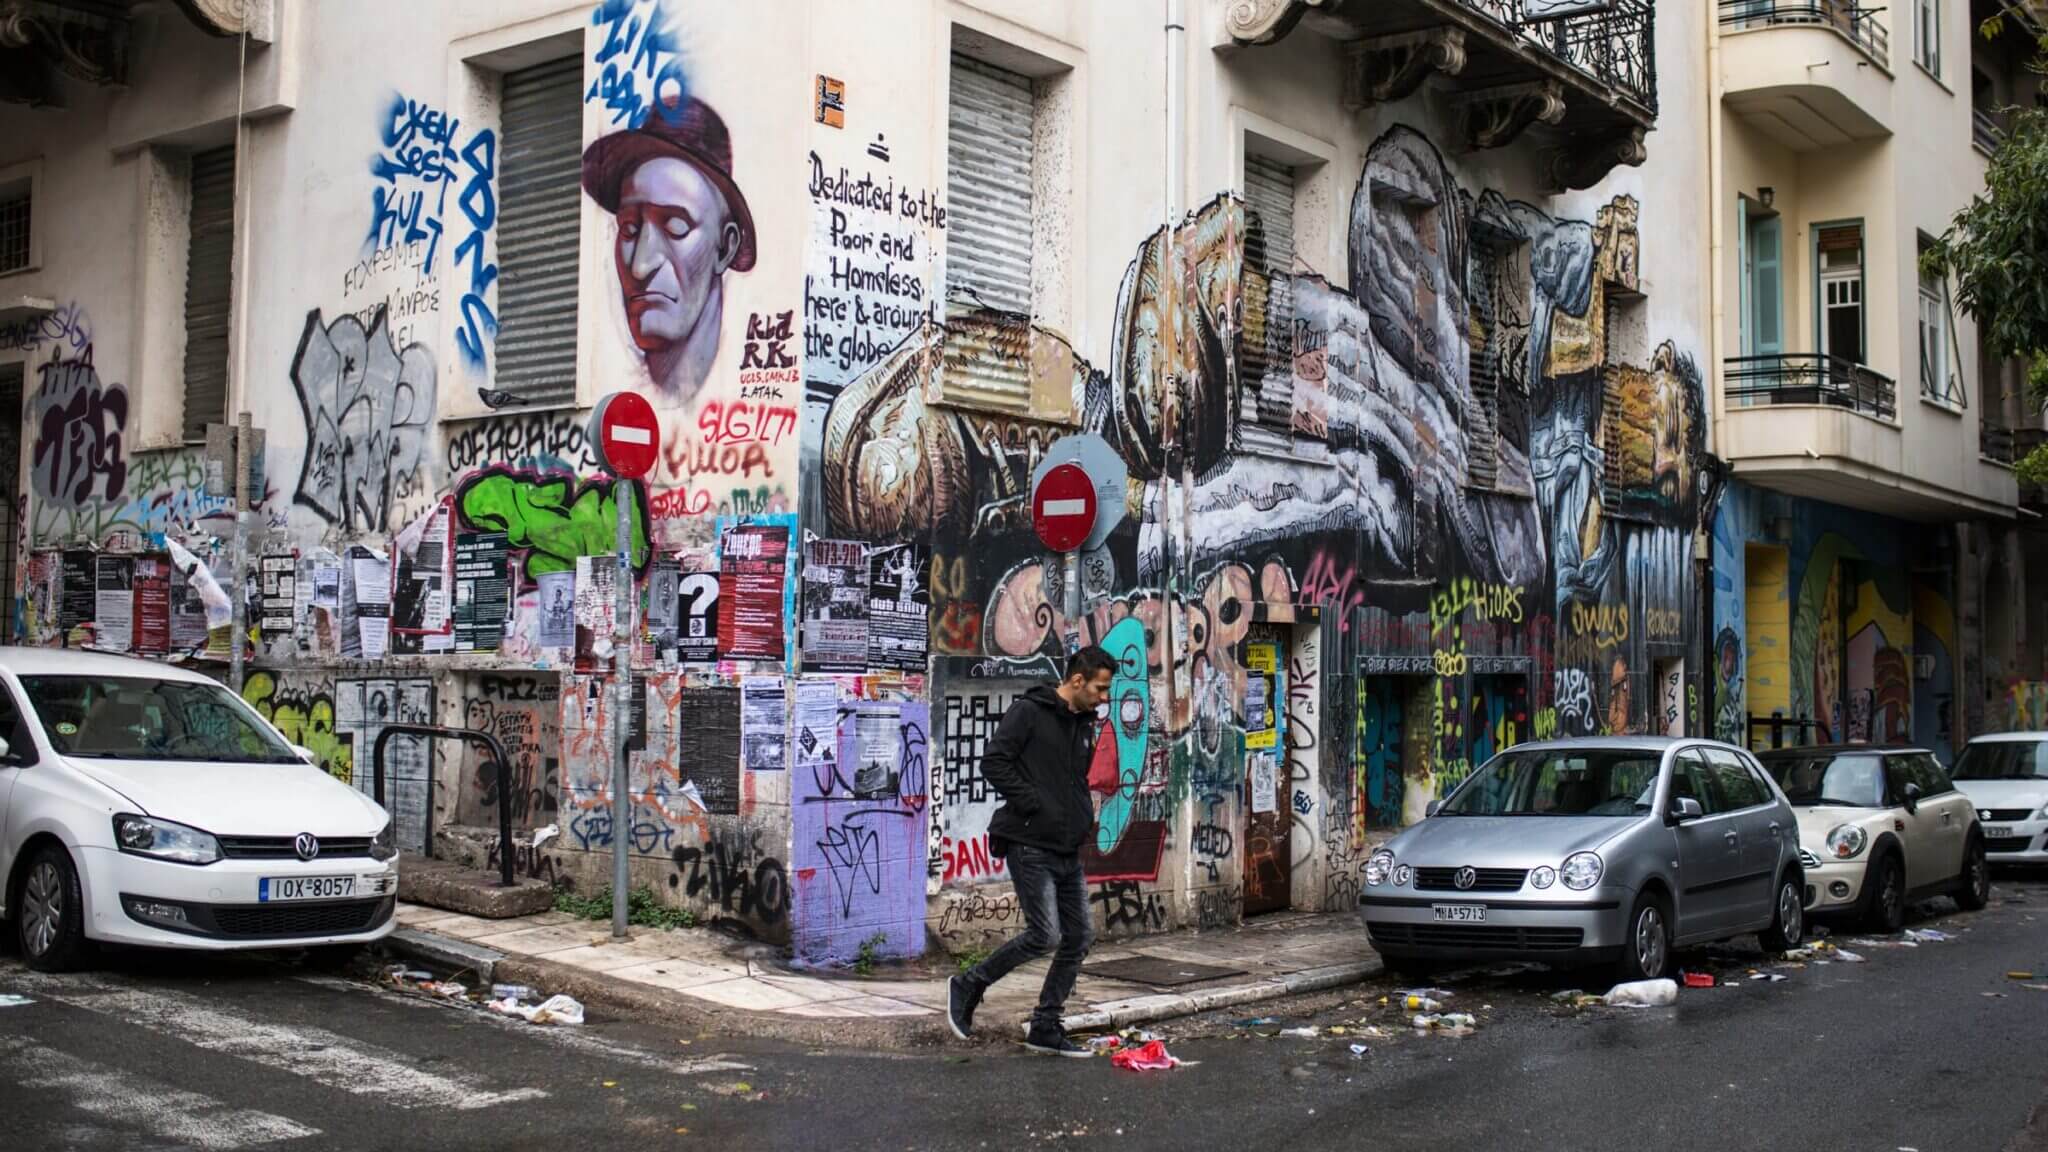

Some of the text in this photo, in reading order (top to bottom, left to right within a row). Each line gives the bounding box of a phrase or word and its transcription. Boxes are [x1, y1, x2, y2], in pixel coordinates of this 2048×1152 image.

[809, 150, 946, 229] Dedicated to the
[831, 207, 914, 261] Poor and
[804, 274, 936, 330] here & around
[804, 325, 892, 371] the globe
